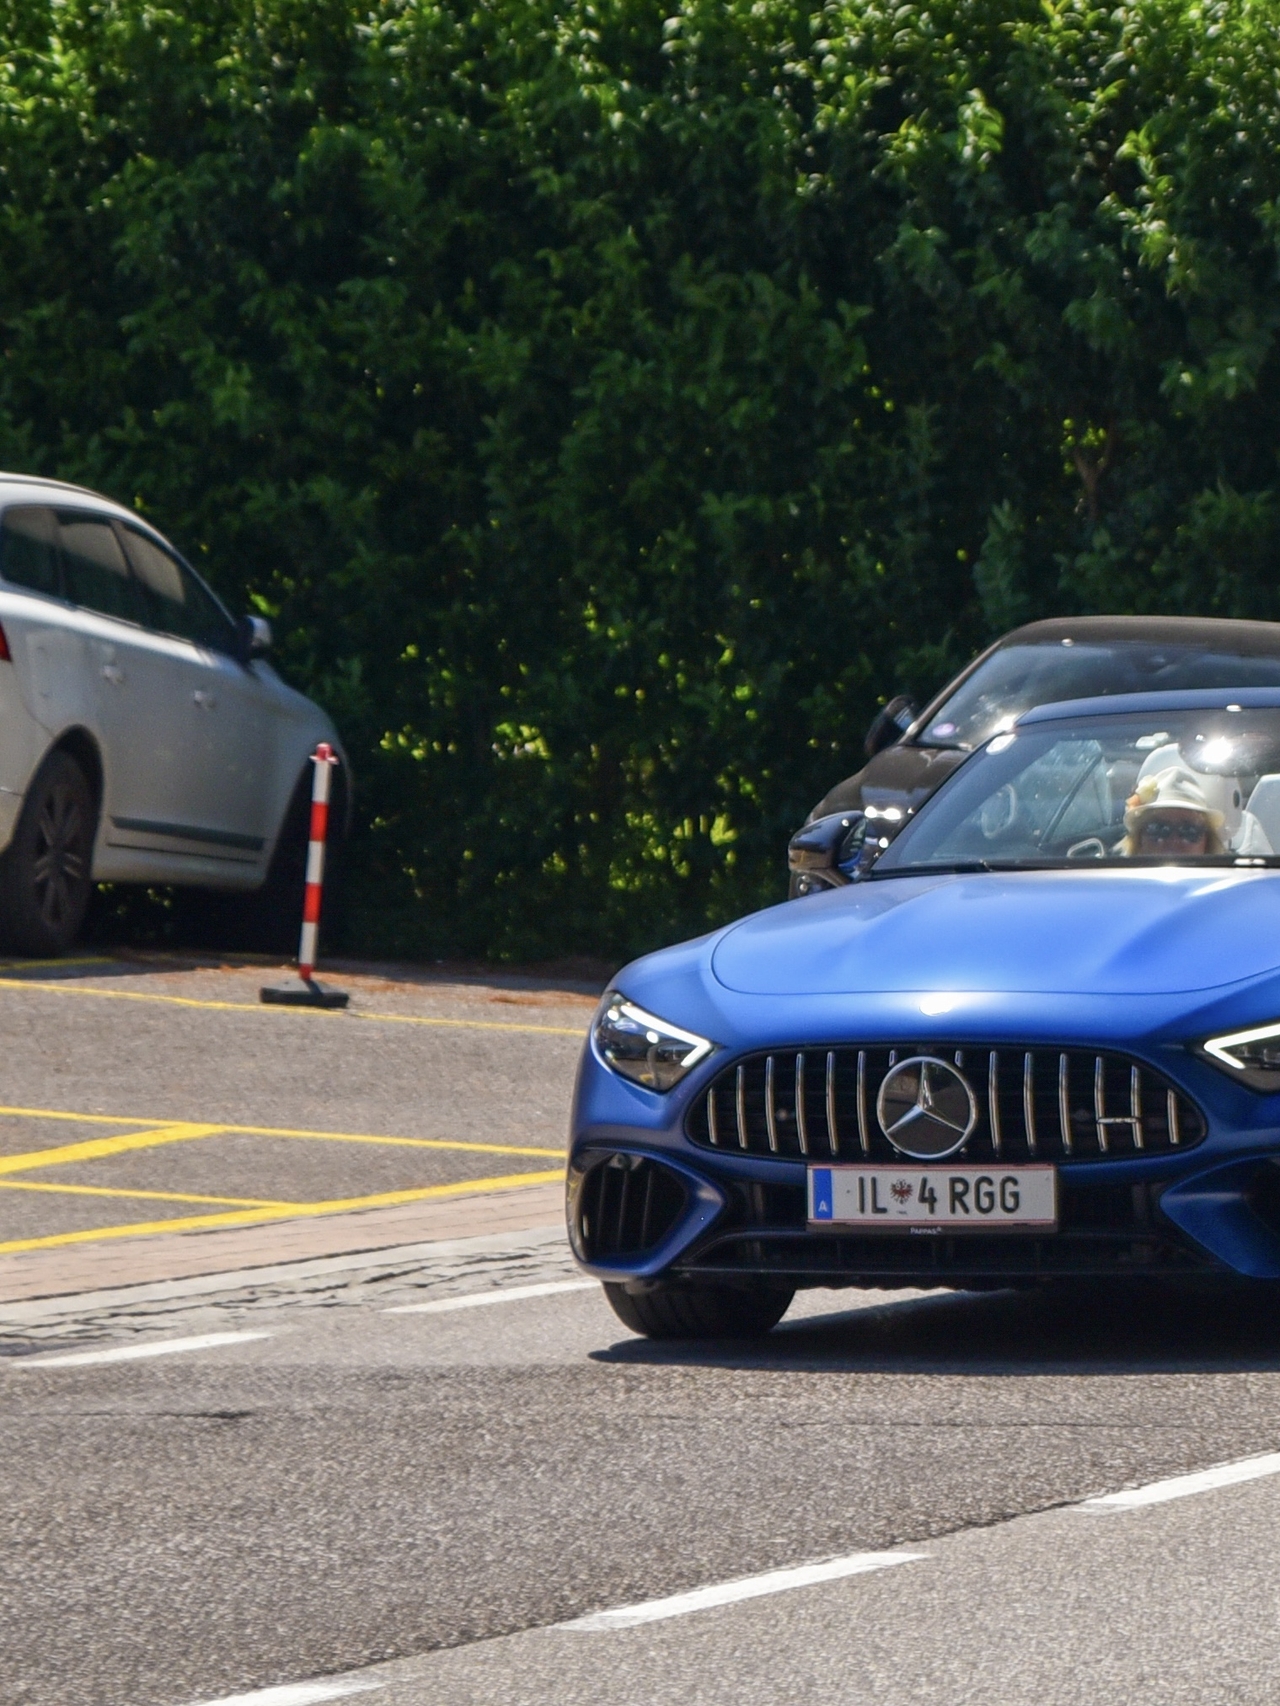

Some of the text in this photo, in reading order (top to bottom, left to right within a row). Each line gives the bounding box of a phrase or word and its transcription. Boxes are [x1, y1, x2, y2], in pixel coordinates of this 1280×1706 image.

[818, 1200, 828, 1212] A
[858, 1175, 1020, 1215] IL 4 RGG
